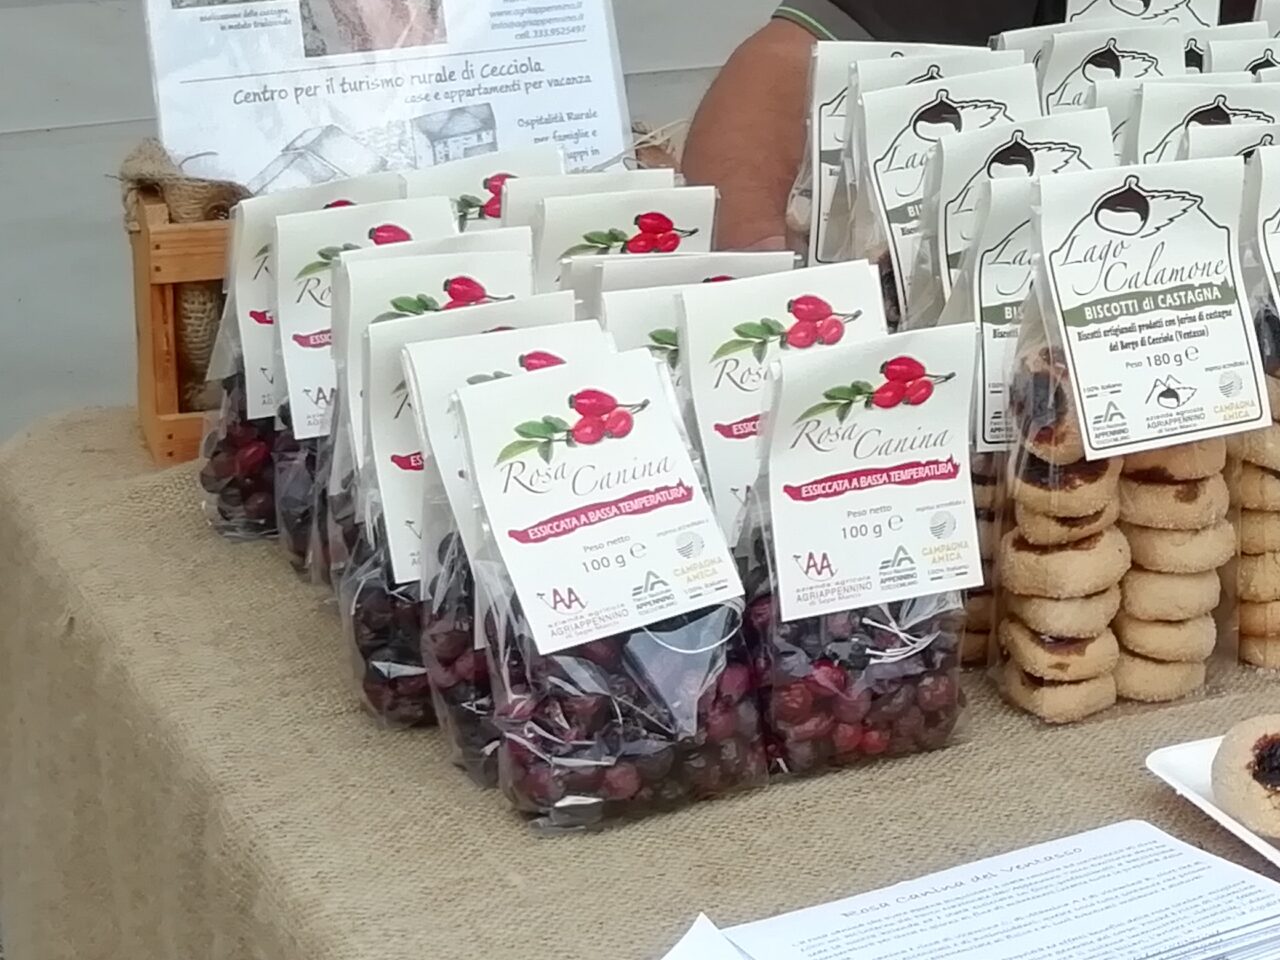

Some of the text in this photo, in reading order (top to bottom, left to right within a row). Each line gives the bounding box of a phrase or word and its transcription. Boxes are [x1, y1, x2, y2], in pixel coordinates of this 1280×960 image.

[233, 56, 545, 105] Centro per il turismo rurale di Cecciola
[404, 74, 592, 104] case e appartamenti per vacanza
[517, 109, 598, 129] Ospitalità Rurale
[552, 129, 589, 144] famiglie
[591, 129, 597, 138] e
[1060, 234, 1131, 295] Lago
[1103, 241, 1228, 292] Calamone
[1084, 285, 1223, 320] BISCOTTI di CASTAGNA
[1077, 309, 1233, 342] Biscotti artigianali prodotti con farina di castagne
[1109, 325, 1210, 353] del Borgo di Cecciola (Ventasso)
[1125, 360, 1143, 370] Peso
[1145, 352, 1171, 368] 180
[1173, 354, 1183, 367] g
[1213, 400, 1256, 415] CAMPAGNA
[790, 419, 949, 460] Rosa Canina
[499, 455, 674, 497] Rosa Canina
[800, 461, 954, 498] ESSICCATA A BASSA TEMPERATURA
[527, 485, 688, 540] ESSICCATA A BASSA TEMPERATURA
[846, 504, 893, 519] Peso netto
[583, 534, 631, 553] Peso netto
[842, 523, 883, 540] 100 g
[582, 554, 626, 573] 100 g
[921, 541, 969, 556] CAMPAGNA
[796, 581, 873, 603] AGRIAPPENNINO
[550, 608, 630, 638] AGRIAPPENNINO
[895, 879, 965, 904] Canina
[970, 871, 998, 884] del
[1001, 845, 1083, 873] Ventasso
